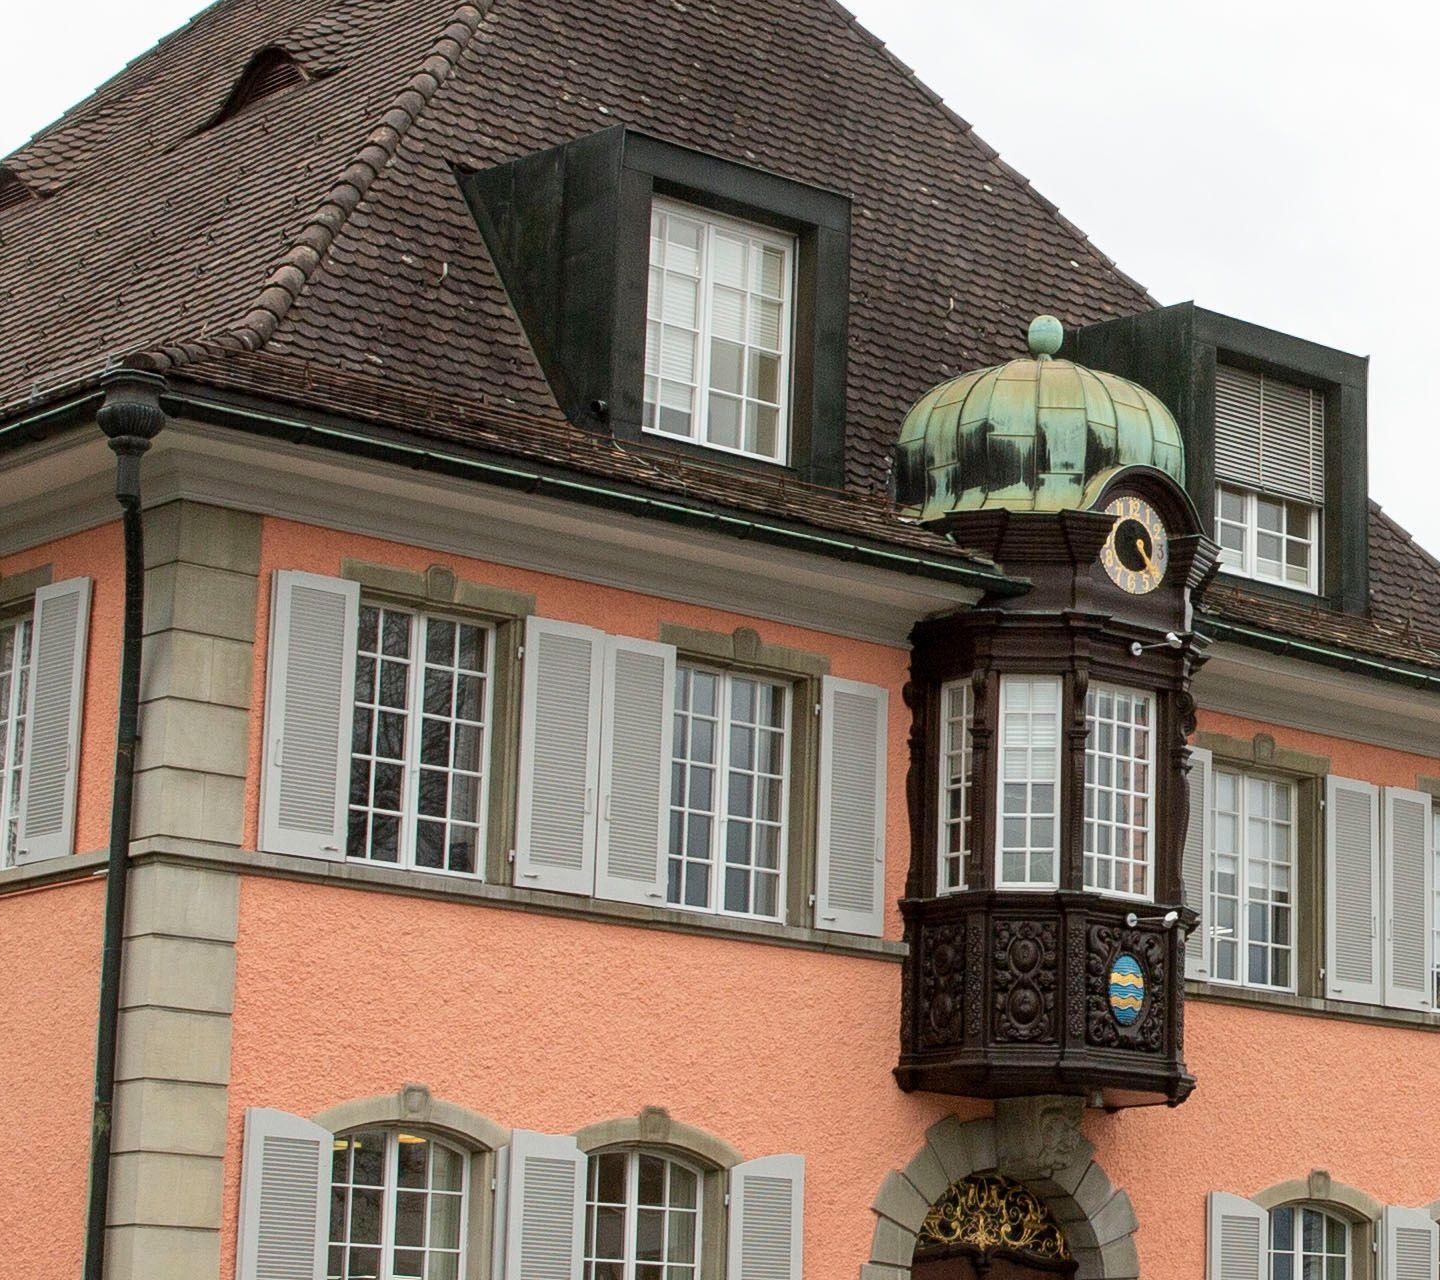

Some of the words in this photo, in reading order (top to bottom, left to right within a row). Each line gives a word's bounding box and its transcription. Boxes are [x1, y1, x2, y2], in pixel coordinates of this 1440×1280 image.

[1129, 500, 1141, 519] 12
[1153, 524, 1162, 540] 2
[1105, 548, 1113, 567] 8
[1157, 544, 1164, 561] 3
[1128, 574, 1136, 593] 6
